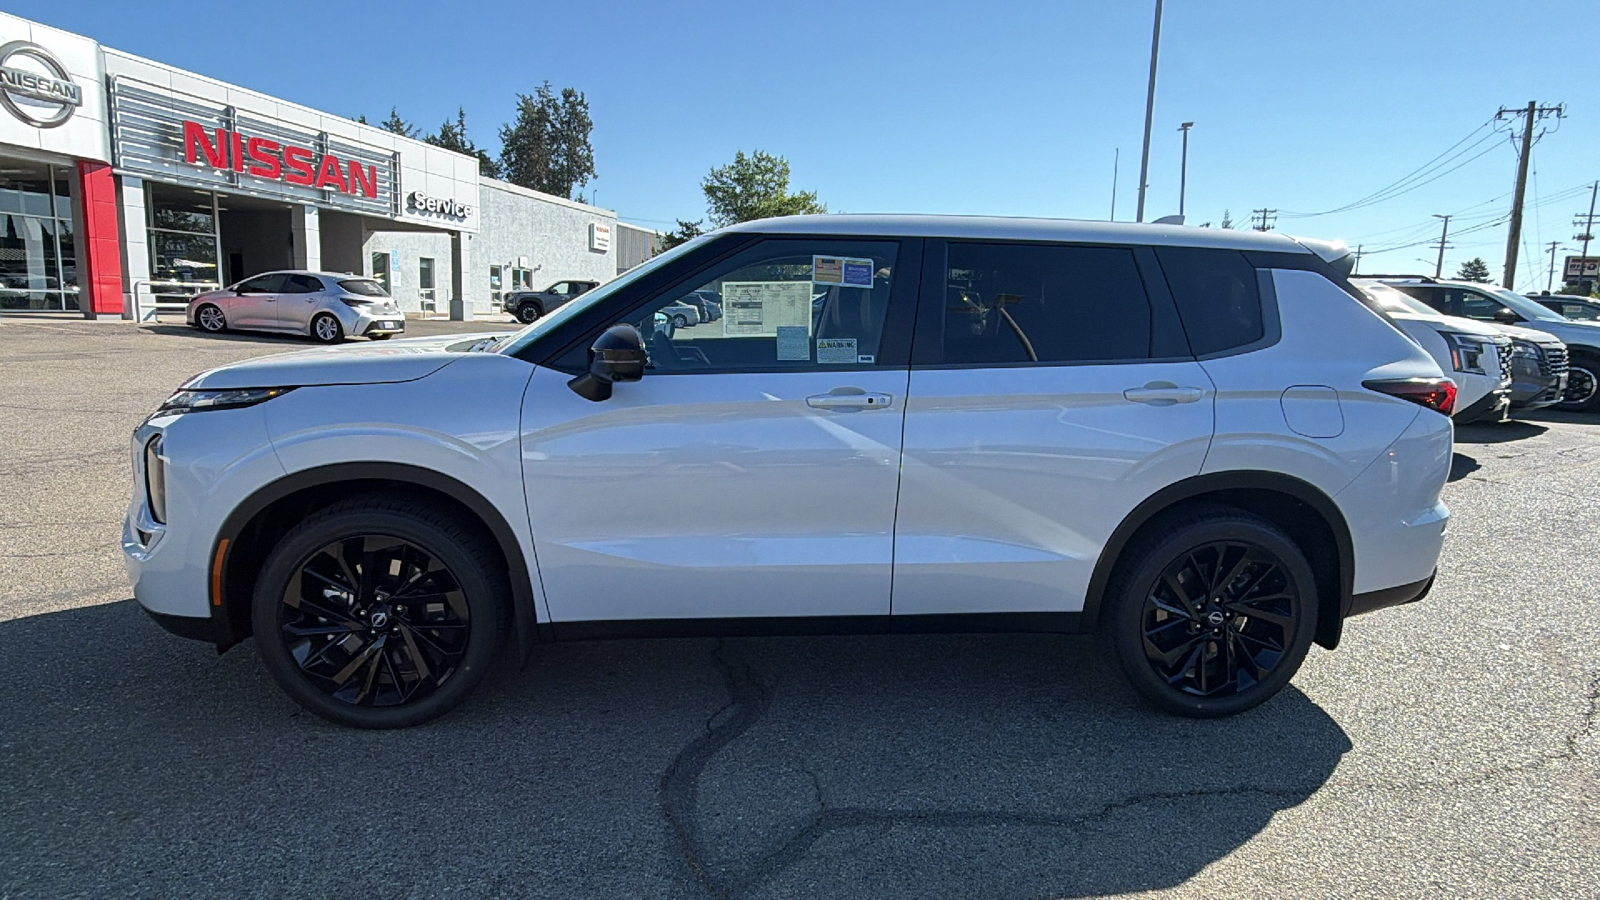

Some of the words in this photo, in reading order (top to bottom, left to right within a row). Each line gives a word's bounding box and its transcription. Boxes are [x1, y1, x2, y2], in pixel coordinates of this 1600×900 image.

[0, 69, 77, 99] NISSAN
[183, 120, 378, 199] NISSAN
[412, 190, 473, 218] Service
